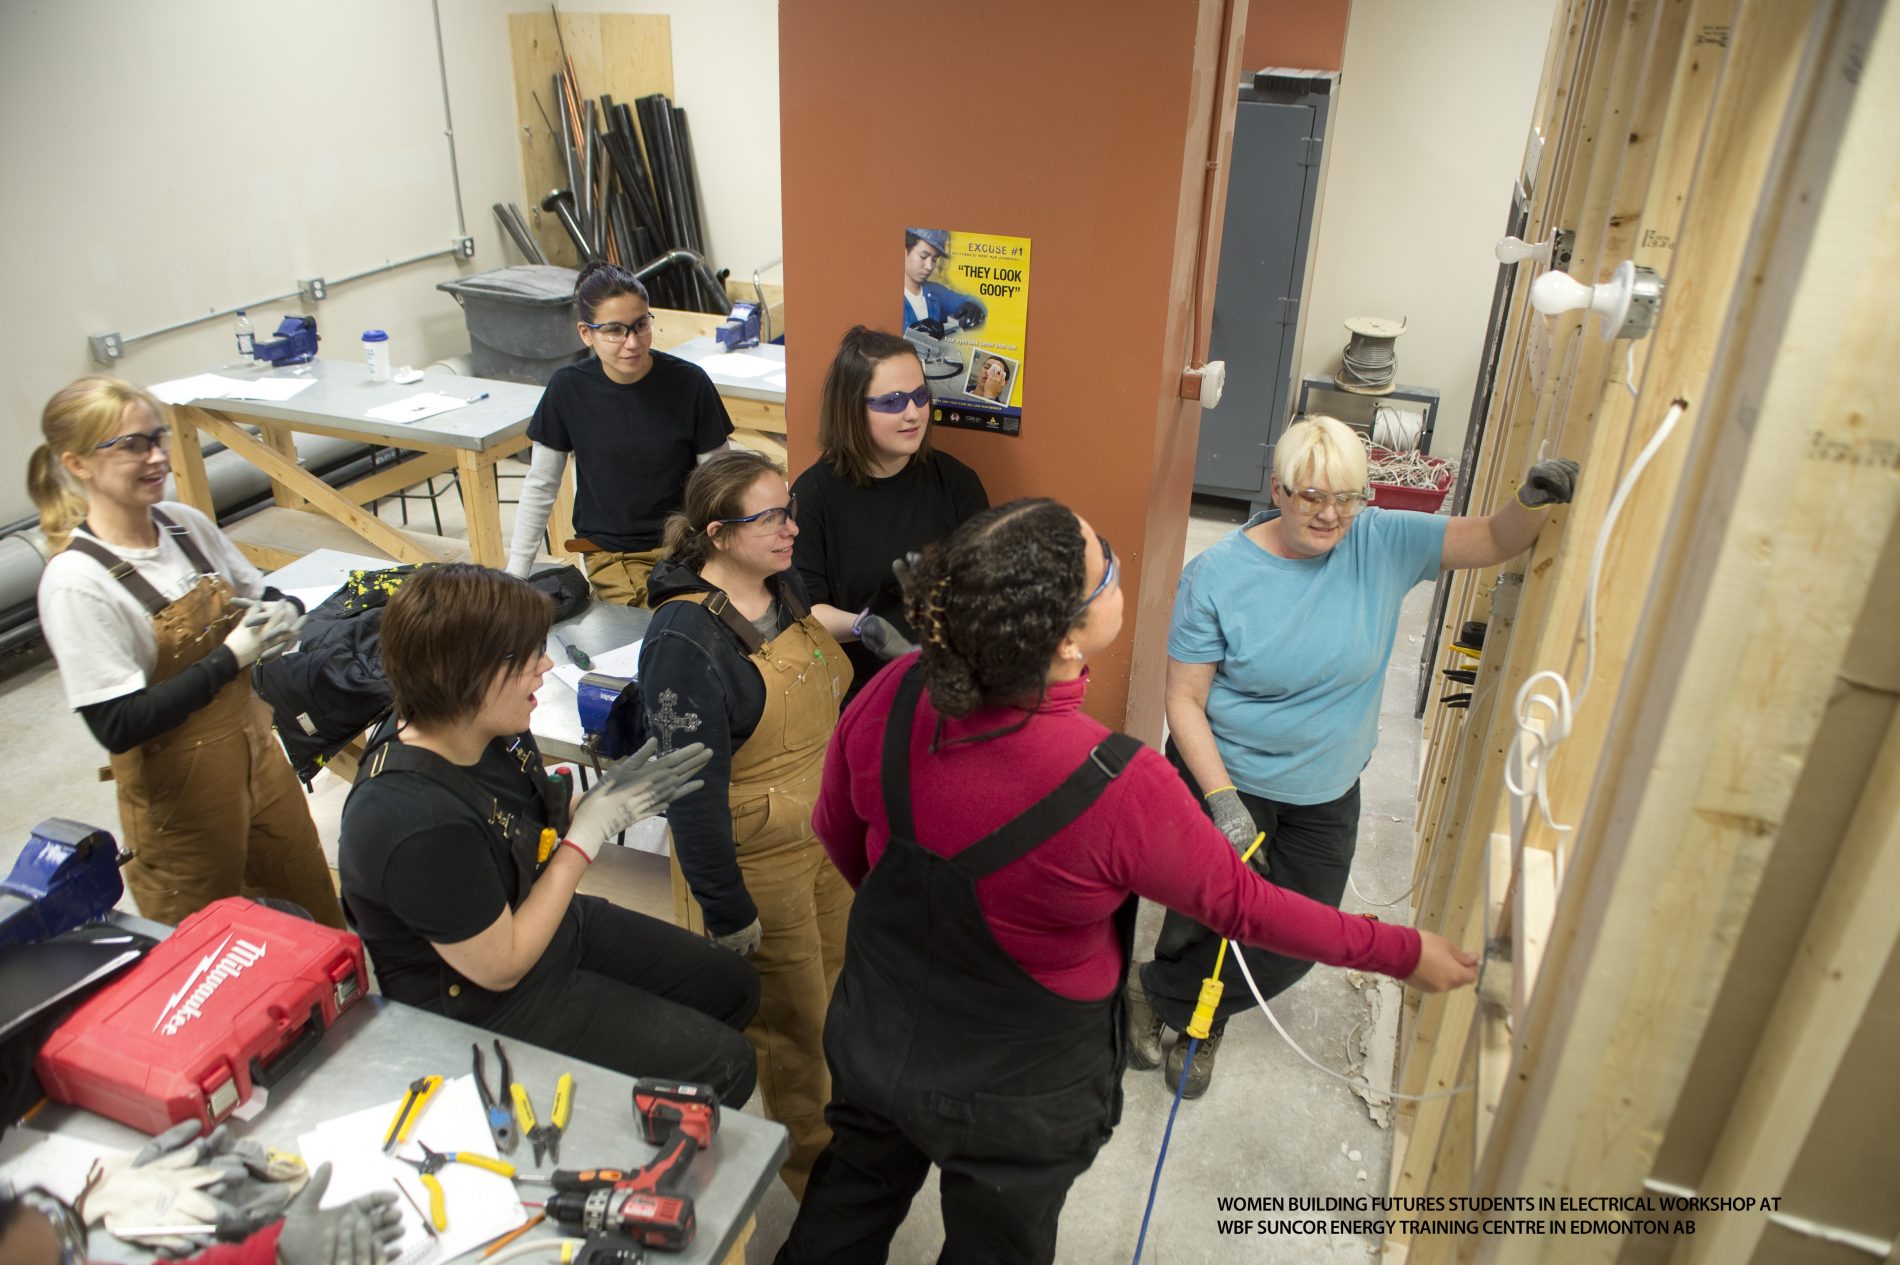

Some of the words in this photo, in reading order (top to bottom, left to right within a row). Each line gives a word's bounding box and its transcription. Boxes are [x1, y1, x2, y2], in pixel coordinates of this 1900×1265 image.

[968, 242, 1007, 255] EXCUSE
[1011, 247, 1023, 256] #1
[958, 264, 990, 279] “THEY
[993, 268, 1022, 282] LOOK
[979, 283, 1021, 298] GOOFY”
[161, 939, 266, 1037] Milwaukee
